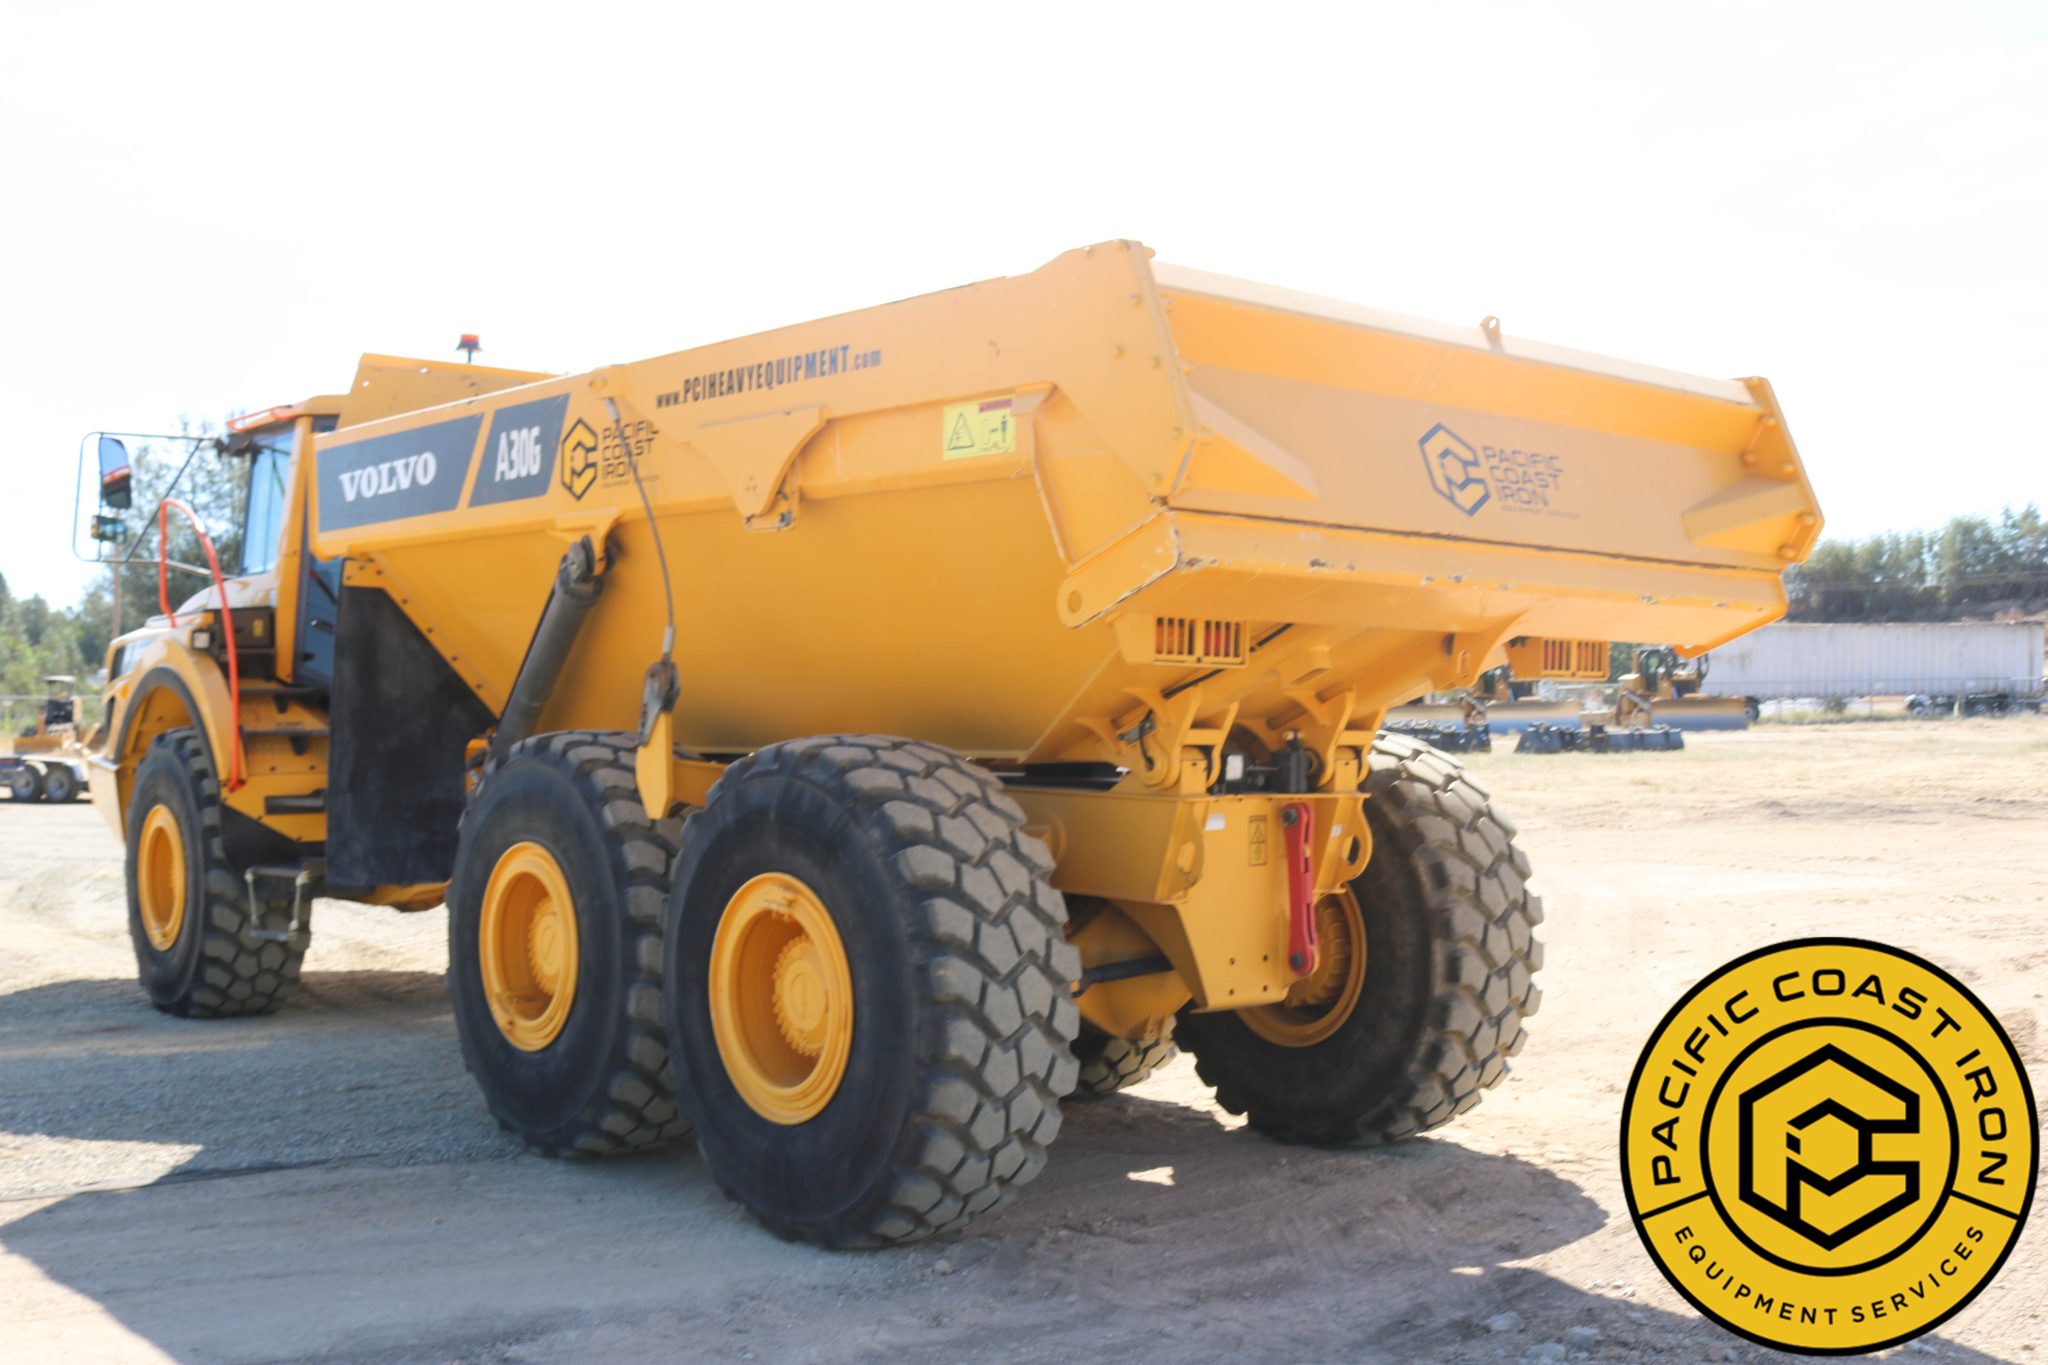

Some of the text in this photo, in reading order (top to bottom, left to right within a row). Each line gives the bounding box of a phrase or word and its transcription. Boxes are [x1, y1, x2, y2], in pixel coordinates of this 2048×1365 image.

[656, 344, 881, 409] www.PCIHEAVYEQUIPMENT.com
[494, 426, 541, 482] A30G
[1482, 445, 1563, 473] PACIFIC
[338, 451, 437, 502] VOLVO
[1489, 465, 1561, 490] COAST
[1495, 485, 1549, 507] IRON
